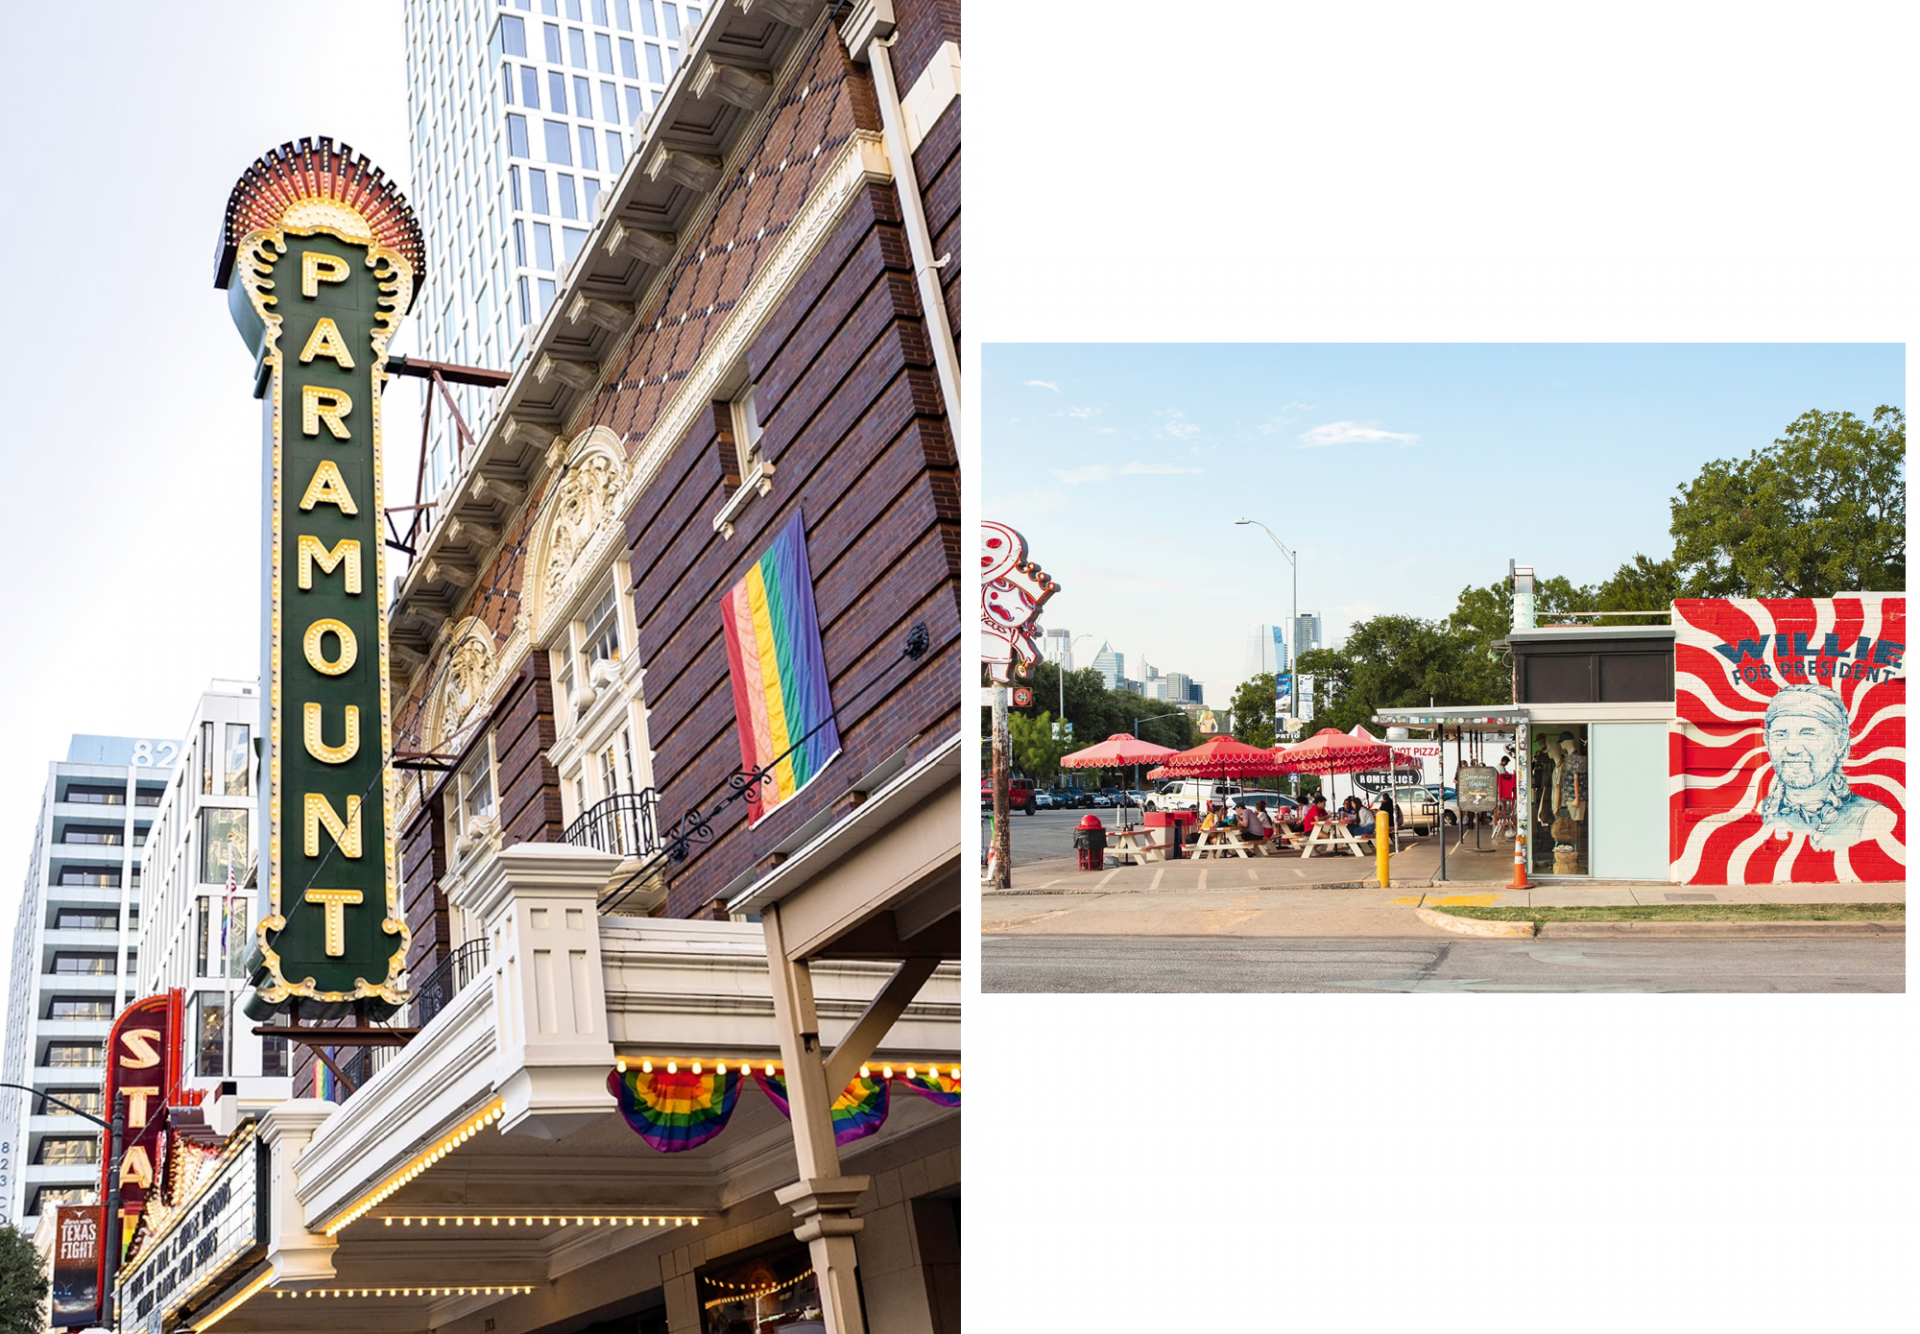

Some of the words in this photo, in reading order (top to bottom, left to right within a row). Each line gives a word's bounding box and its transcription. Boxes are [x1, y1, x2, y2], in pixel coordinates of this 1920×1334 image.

[298, 250, 365, 959] PARAMOUNT
[1714, 632, 1906, 669] WILLIE
[1731, 663, 1773, 686] FOR
[1780, 660, 1896, 686] PRESIDENT
[1413, 747, 1440, 756] PIZZA
[1359, 774, 1386, 784] HOME
[1387, 774, 1414, 784] SLICE
[61, 1223, 97, 1242] TEXAS
[61, 1241, 95, 1259] FIGHT
